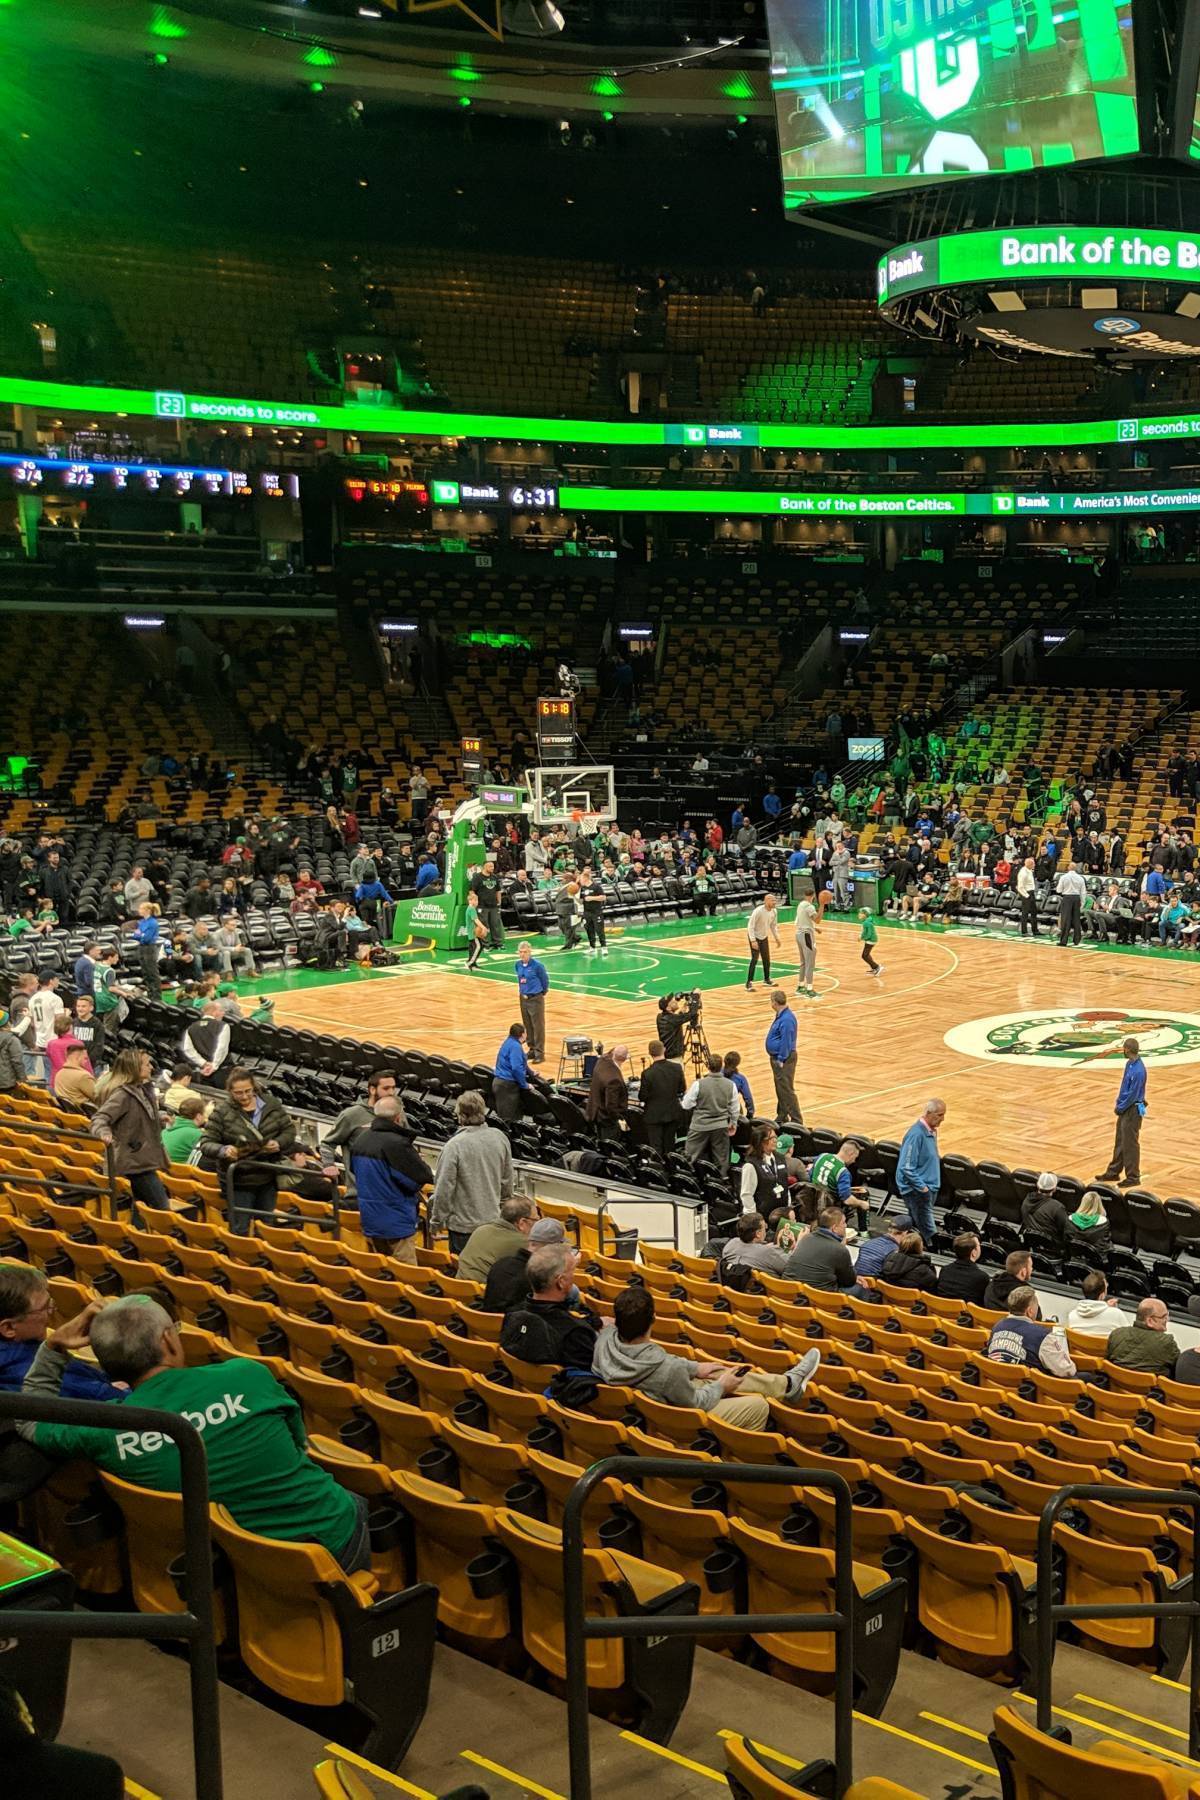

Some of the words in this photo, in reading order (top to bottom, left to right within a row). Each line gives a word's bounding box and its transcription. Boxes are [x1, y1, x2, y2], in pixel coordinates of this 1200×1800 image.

[1002, 236, 1076, 265] Bank
[1082, 237, 1115, 264] of
[1122, 237, 1171, 266] the
[889, 251, 924, 281] Bank
[162, 397, 181, 413] 23
[191, 403, 255, 418] seconds
[257, 408, 273, 419] to
[688, 429, 703, 441] TD
[709, 428, 742, 440] Bank
[1121, 423, 1135, 437] 23
[1142, 420, 1189, 435] seconds
[23, 461, 36, 469] FG
[72, 465, 90, 473] 3PT
[115, 468, 128, 476] TO
[17, 469, 42, 481] 3/4
[68, 473, 94, 484] 2/2
[146, 470, 162, 478] STL
[177, 472, 194, 480] AST
[439, 488, 456, 498] TD
[463, 486, 499, 498] Bank
[512, 487, 555, 505] 6:31
[780, 497, 814, 510] Bank
[817, 497, 833, 510] of
[835, 498, 857, 510] the
[859, 499, 904, 511] Boston
[906, 499, 955, 511] Celtics.
[996, 497, 1011, 510] TD
[1017, 497, 1049, 507] Bank
[1073, 496, 1121, 508] America's
[1123, 494, 1148, 506] Most
[418, 901, 440, 912] Boston
[412, 907, 447, 921] Scientific
[990, 1016, 1075, 1041] BOSTON
[869, 1616, 880, 1632] 10
[376, 1633, 396, 1653] 12
